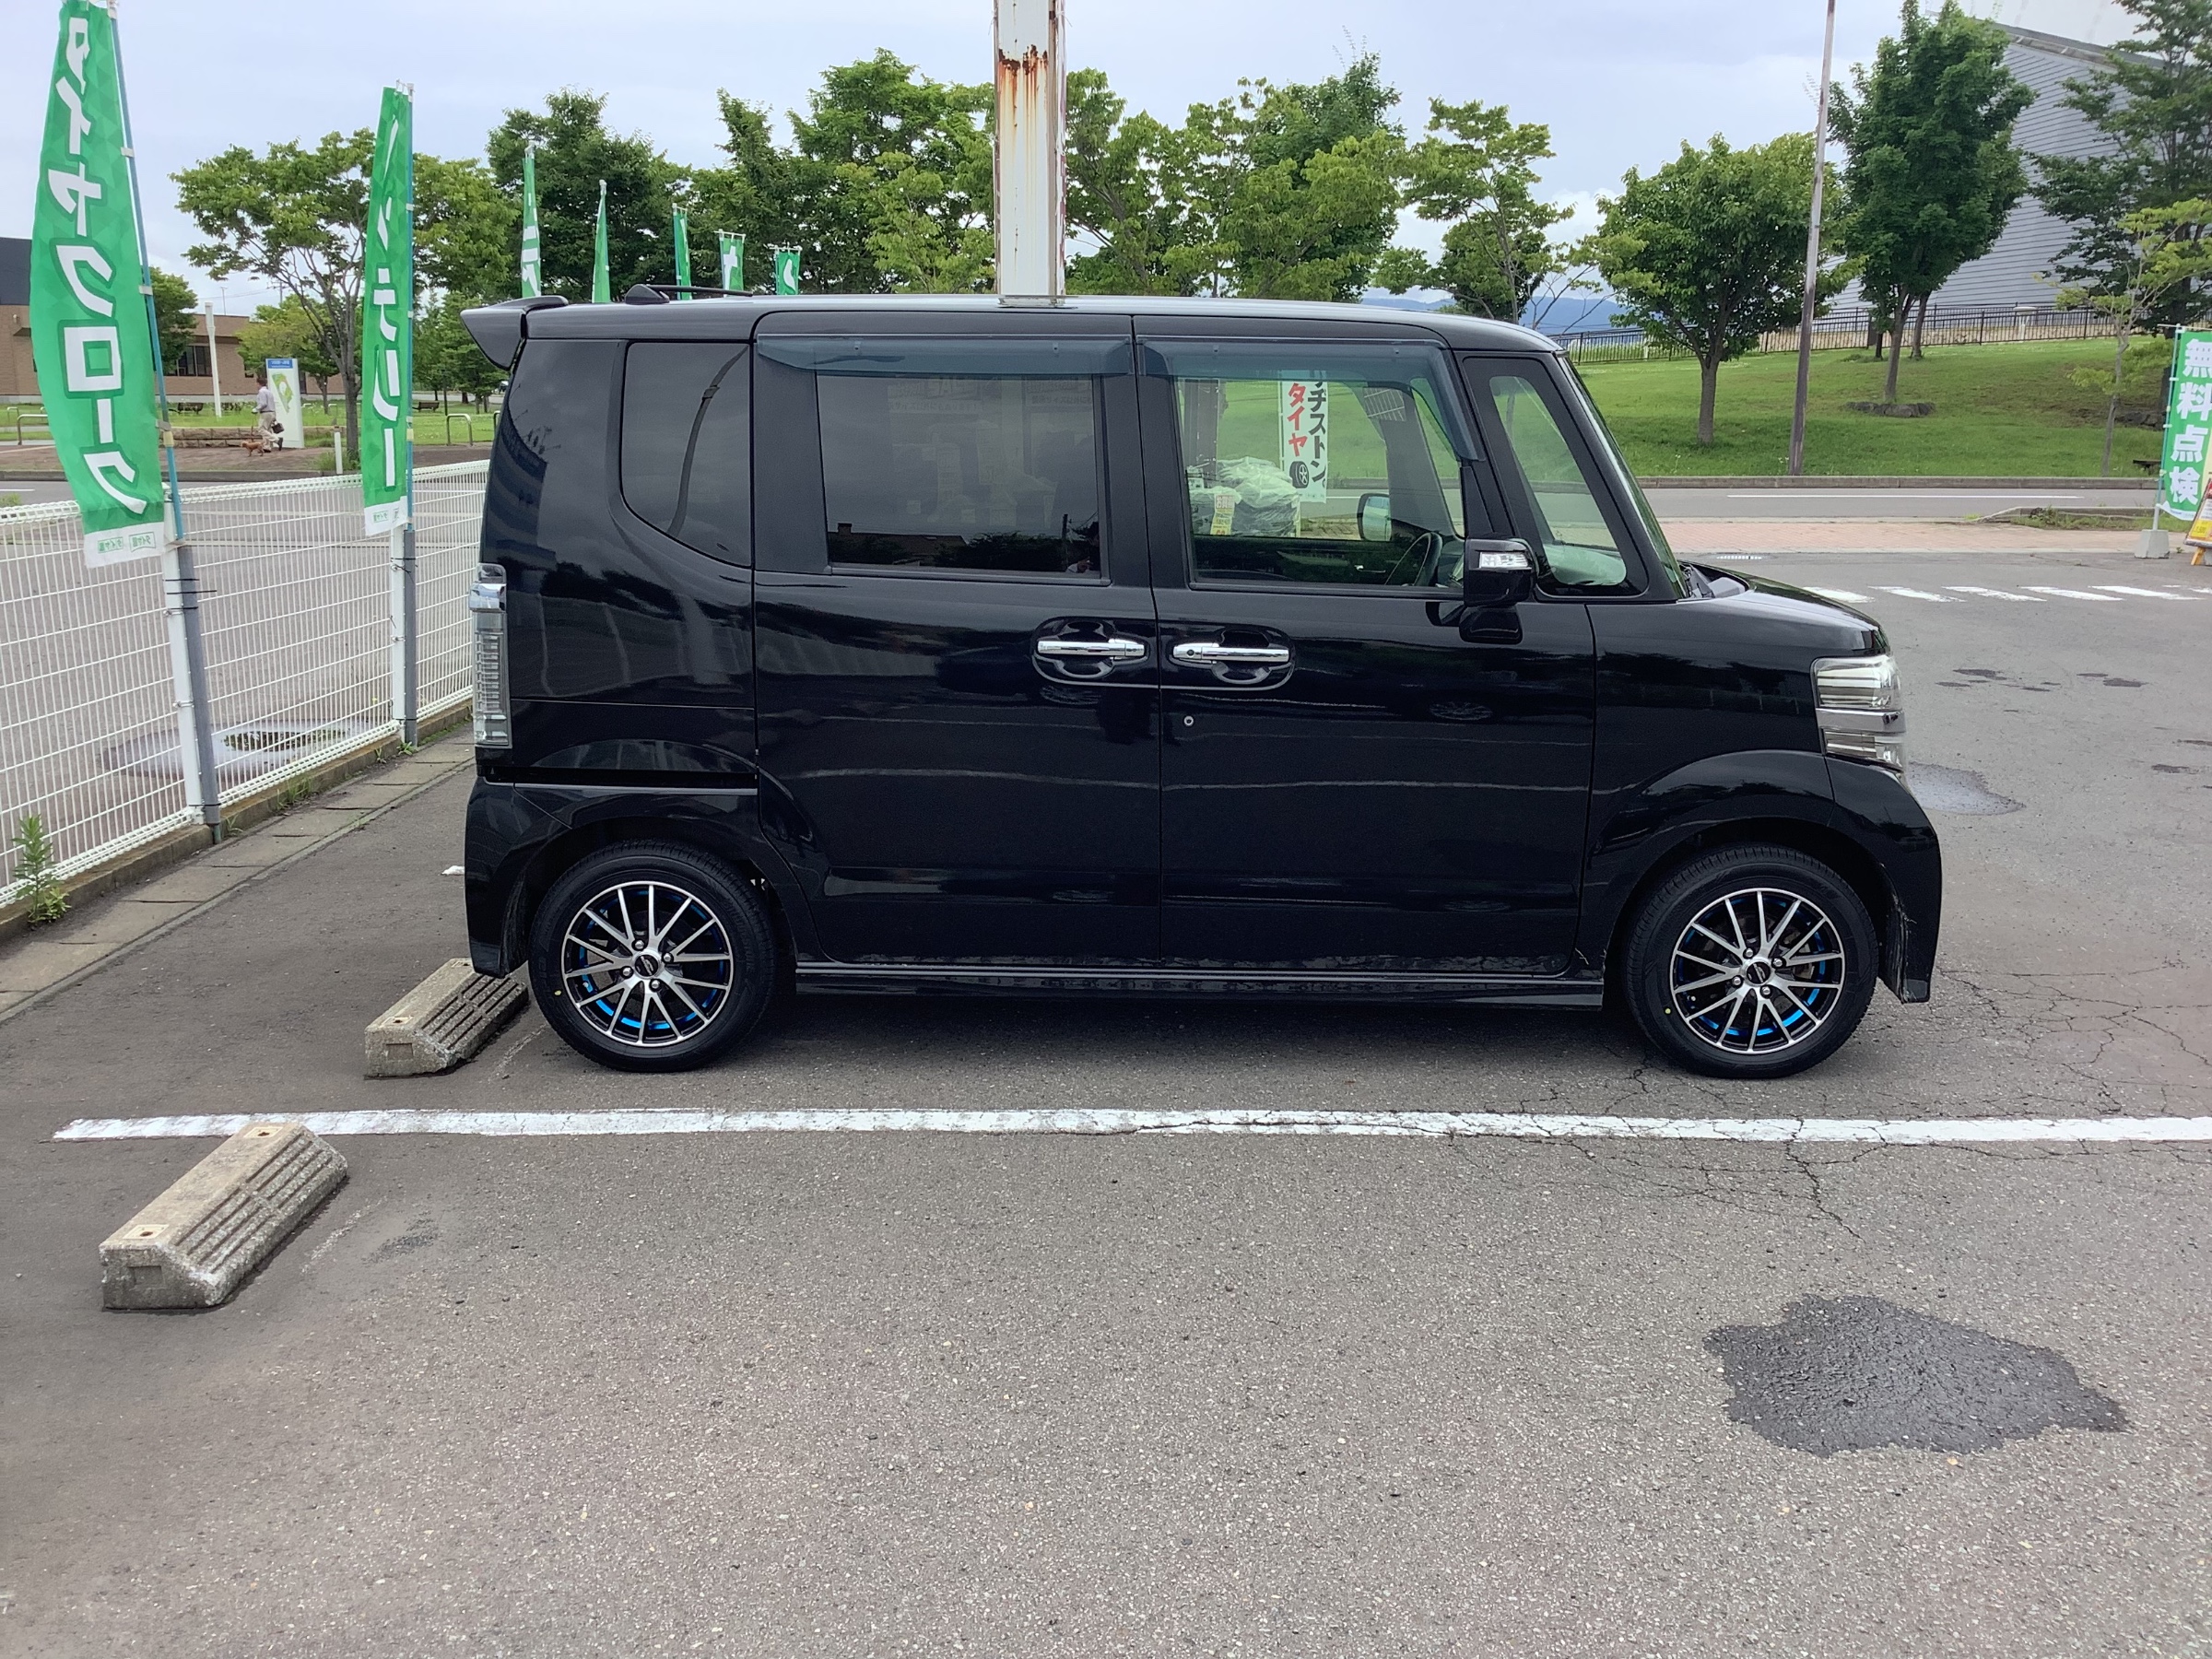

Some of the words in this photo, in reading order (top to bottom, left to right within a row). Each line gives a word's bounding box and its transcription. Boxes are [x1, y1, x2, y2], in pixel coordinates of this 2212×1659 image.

[1287, 382, 1308, 457] タイヤ
[2169, 338, 2212, 506] 無料点検
